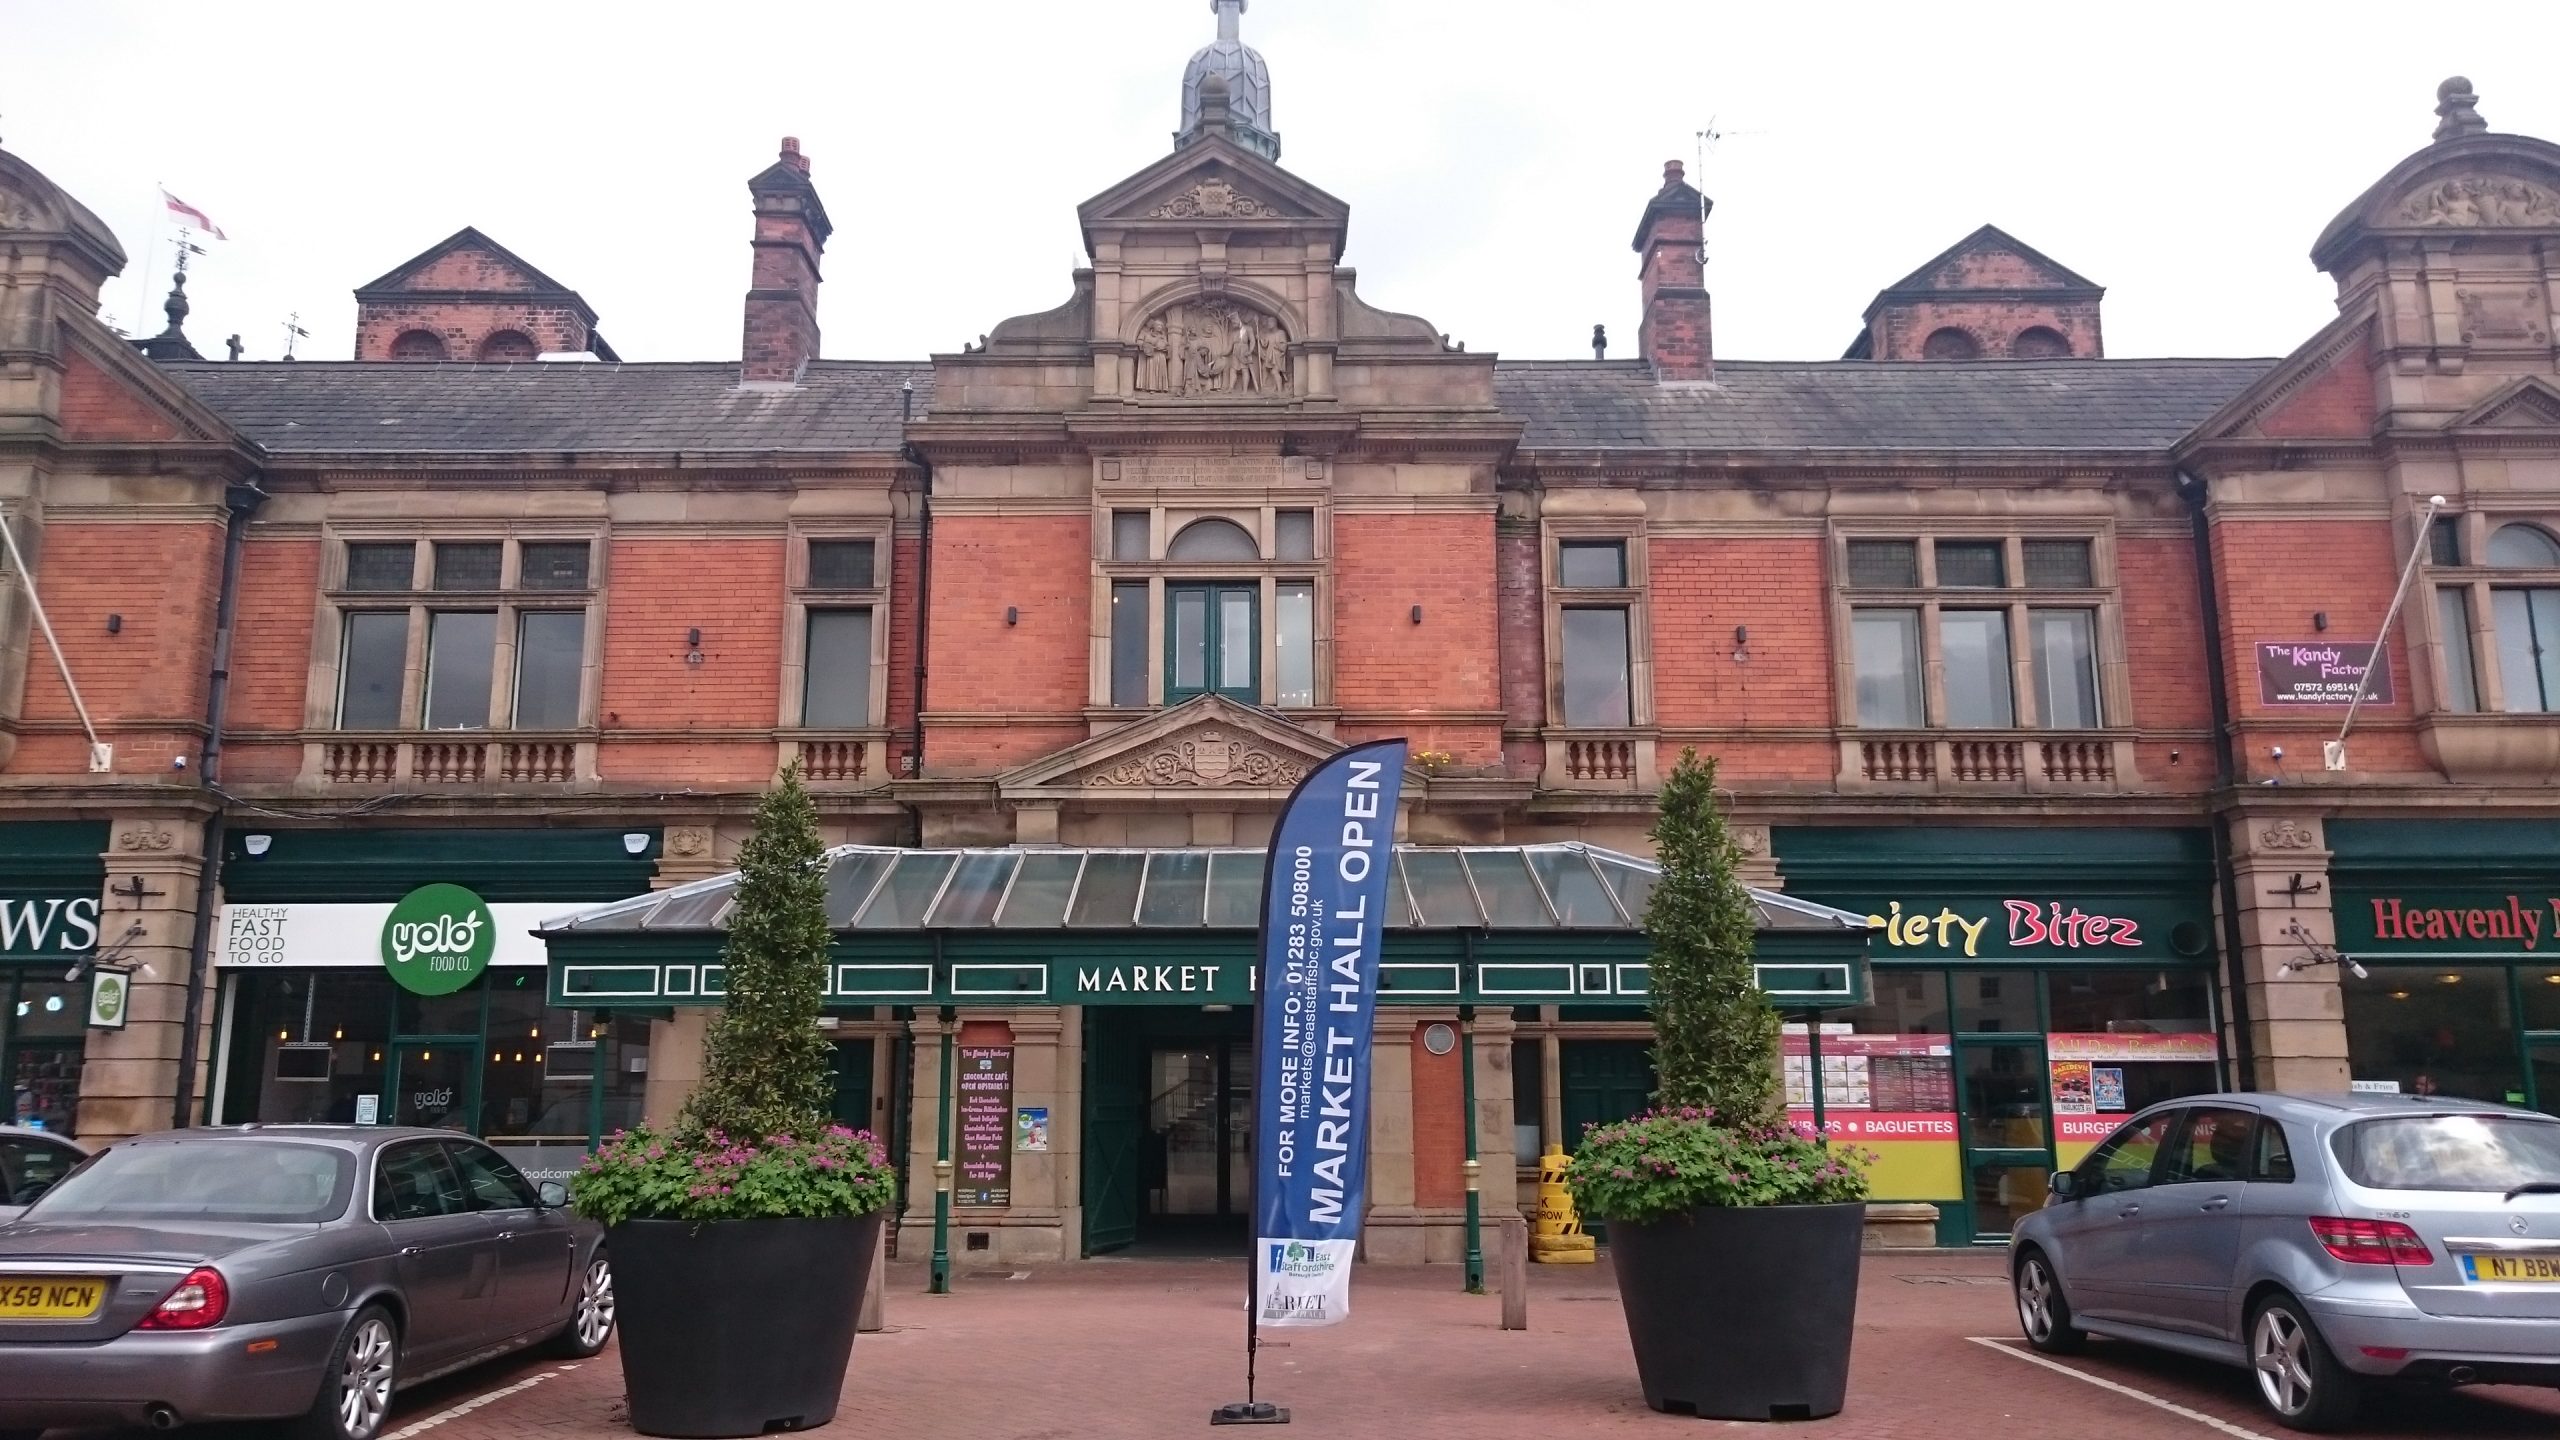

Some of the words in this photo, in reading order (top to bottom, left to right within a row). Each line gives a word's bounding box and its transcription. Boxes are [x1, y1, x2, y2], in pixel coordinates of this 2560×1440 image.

[2266, 645, 2291, 658] The
[2292, 646, 2341, 667] Kandy
[2321, 663, 2369, 679] Factor
[2294, 683, 2323, 692] 07572
[2325, 683, 2360, 692] 695141
[1339, 761, 1382, 883] OPEN
[1290, 845, 1312, 917] 508000
[232, 908, 288, 919] HEALTHY
[2370, 895, 2544, 950] Heavenly
[230, 918, 288, 936] FAST
[2003, 900, 2143, 948] Bitez
[228, 937, 285, 951] FOOD
[392, 912, 477, 963] yolo
[228, 951, 250, 964] TO
[257, 951, 284, 964] GO
[1286, 923, 1306, 984] 01283
[1329, 895, 1366, 1012] HALL
[430, 956, 455, 972] FOOD
[457, 956, 473, 972] CO.
[1077, 966, 1220, 992] MARKET
[1299, 899, 1324, 1119] markets@eaststaffsbc.gov.uk
[1283, 990, 1302, 1050] INFO:
[2057, 1039, 2081, 1052] All
[2088, 1039, 2121, 1056] Day
[2053, 1064, 2089, 1075] DAREDEVIL
[1279, 1056, 1299, 1124] MORE
[1308, 1027, 1354, 1224] MARKET
[1865, 1121, 1953, 1133] BAGUETTES
[2063, 1121, 2122, 1134] BURGE
[1278, 1130, 1295, 1177] FOR
[1540, 1211, 1563, 1220] ROW
[1281, 1261, 1335, 1272] Staffordshire
[1315, 1253, 1331, 1262] East
[2491, 1258, 2517, 1277] N7
[46, 1286, 94, 1308] NCN
